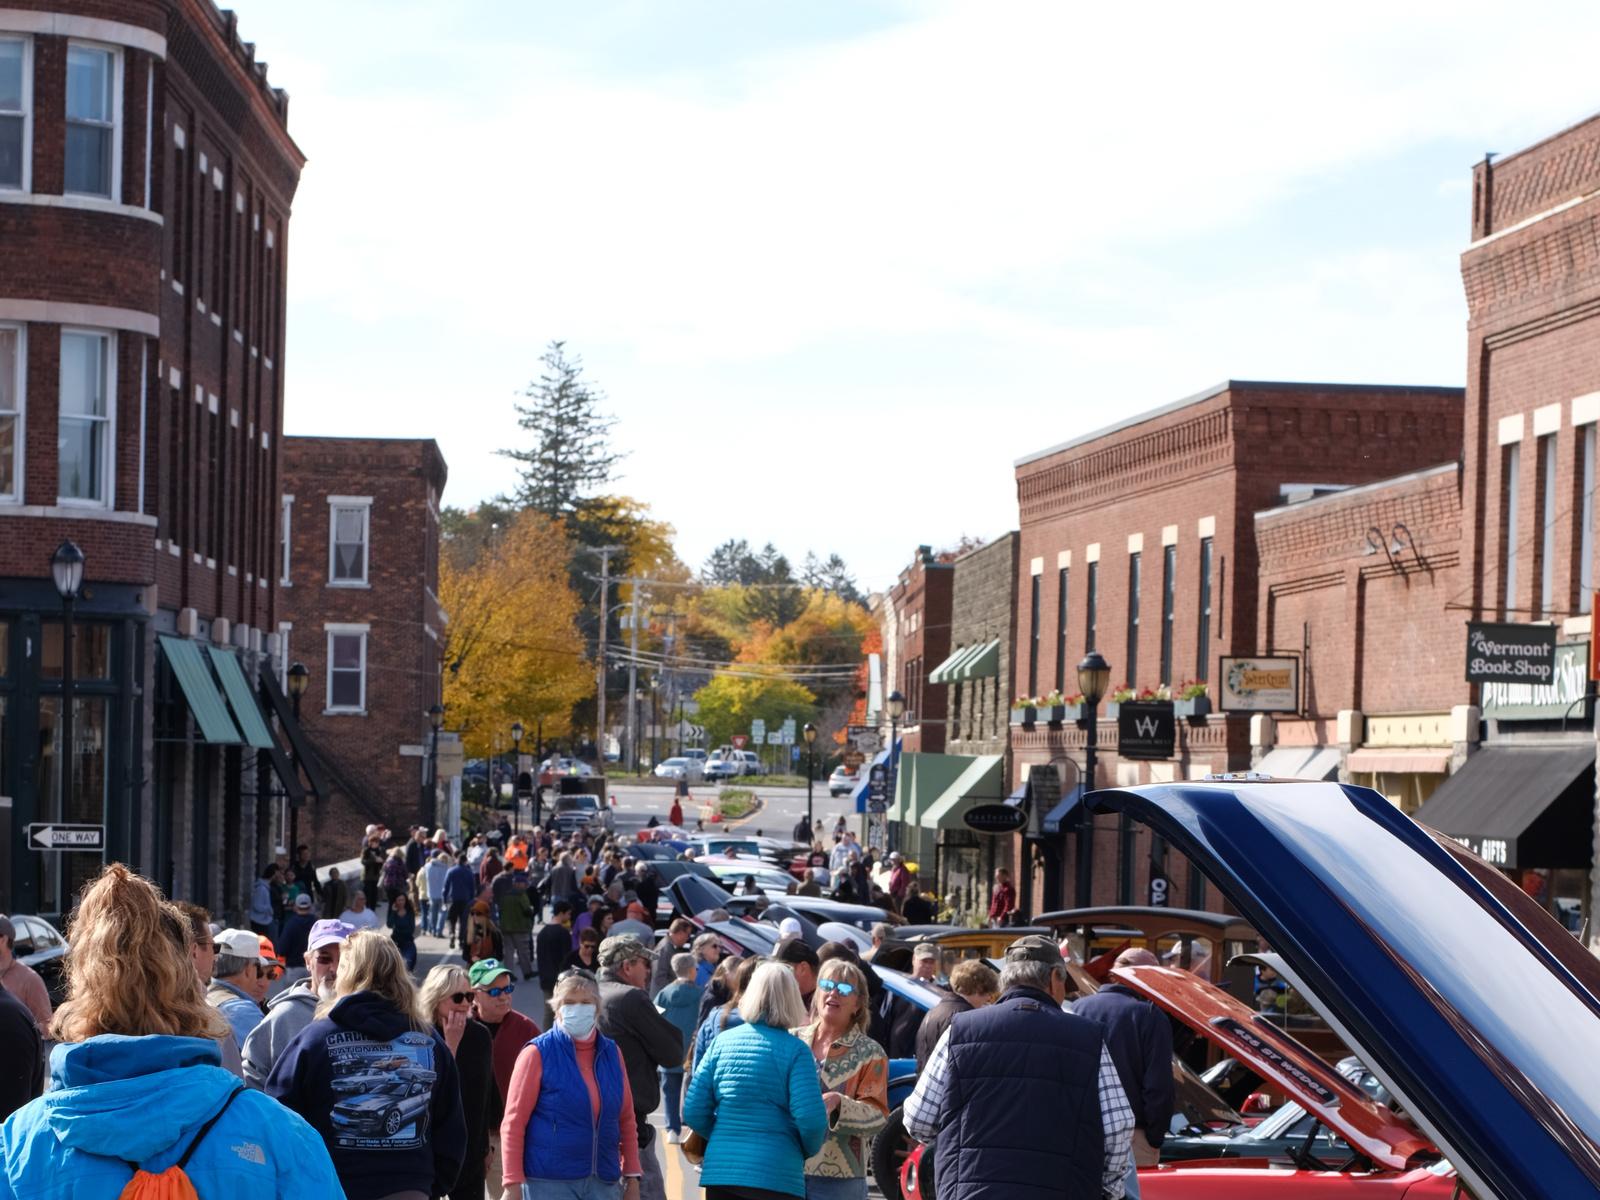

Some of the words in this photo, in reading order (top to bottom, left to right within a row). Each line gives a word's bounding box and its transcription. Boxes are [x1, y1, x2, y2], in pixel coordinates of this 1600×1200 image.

[1477, 641, 1551, 657] Vermont
[1470, 658, 1513, 675] Book
[1514, 660, 1551, 681] Shop
[51, 832, 71, 842] ONE
[75, 832, 96, 842] WAY
[1481, 839, 1507, 864] GIFTS
[1151, 878, 1168, 907] OP
[328, 1044, 393, 1057] NATIONALS
[1281, 1061, 1329, 1096] WEDGE
